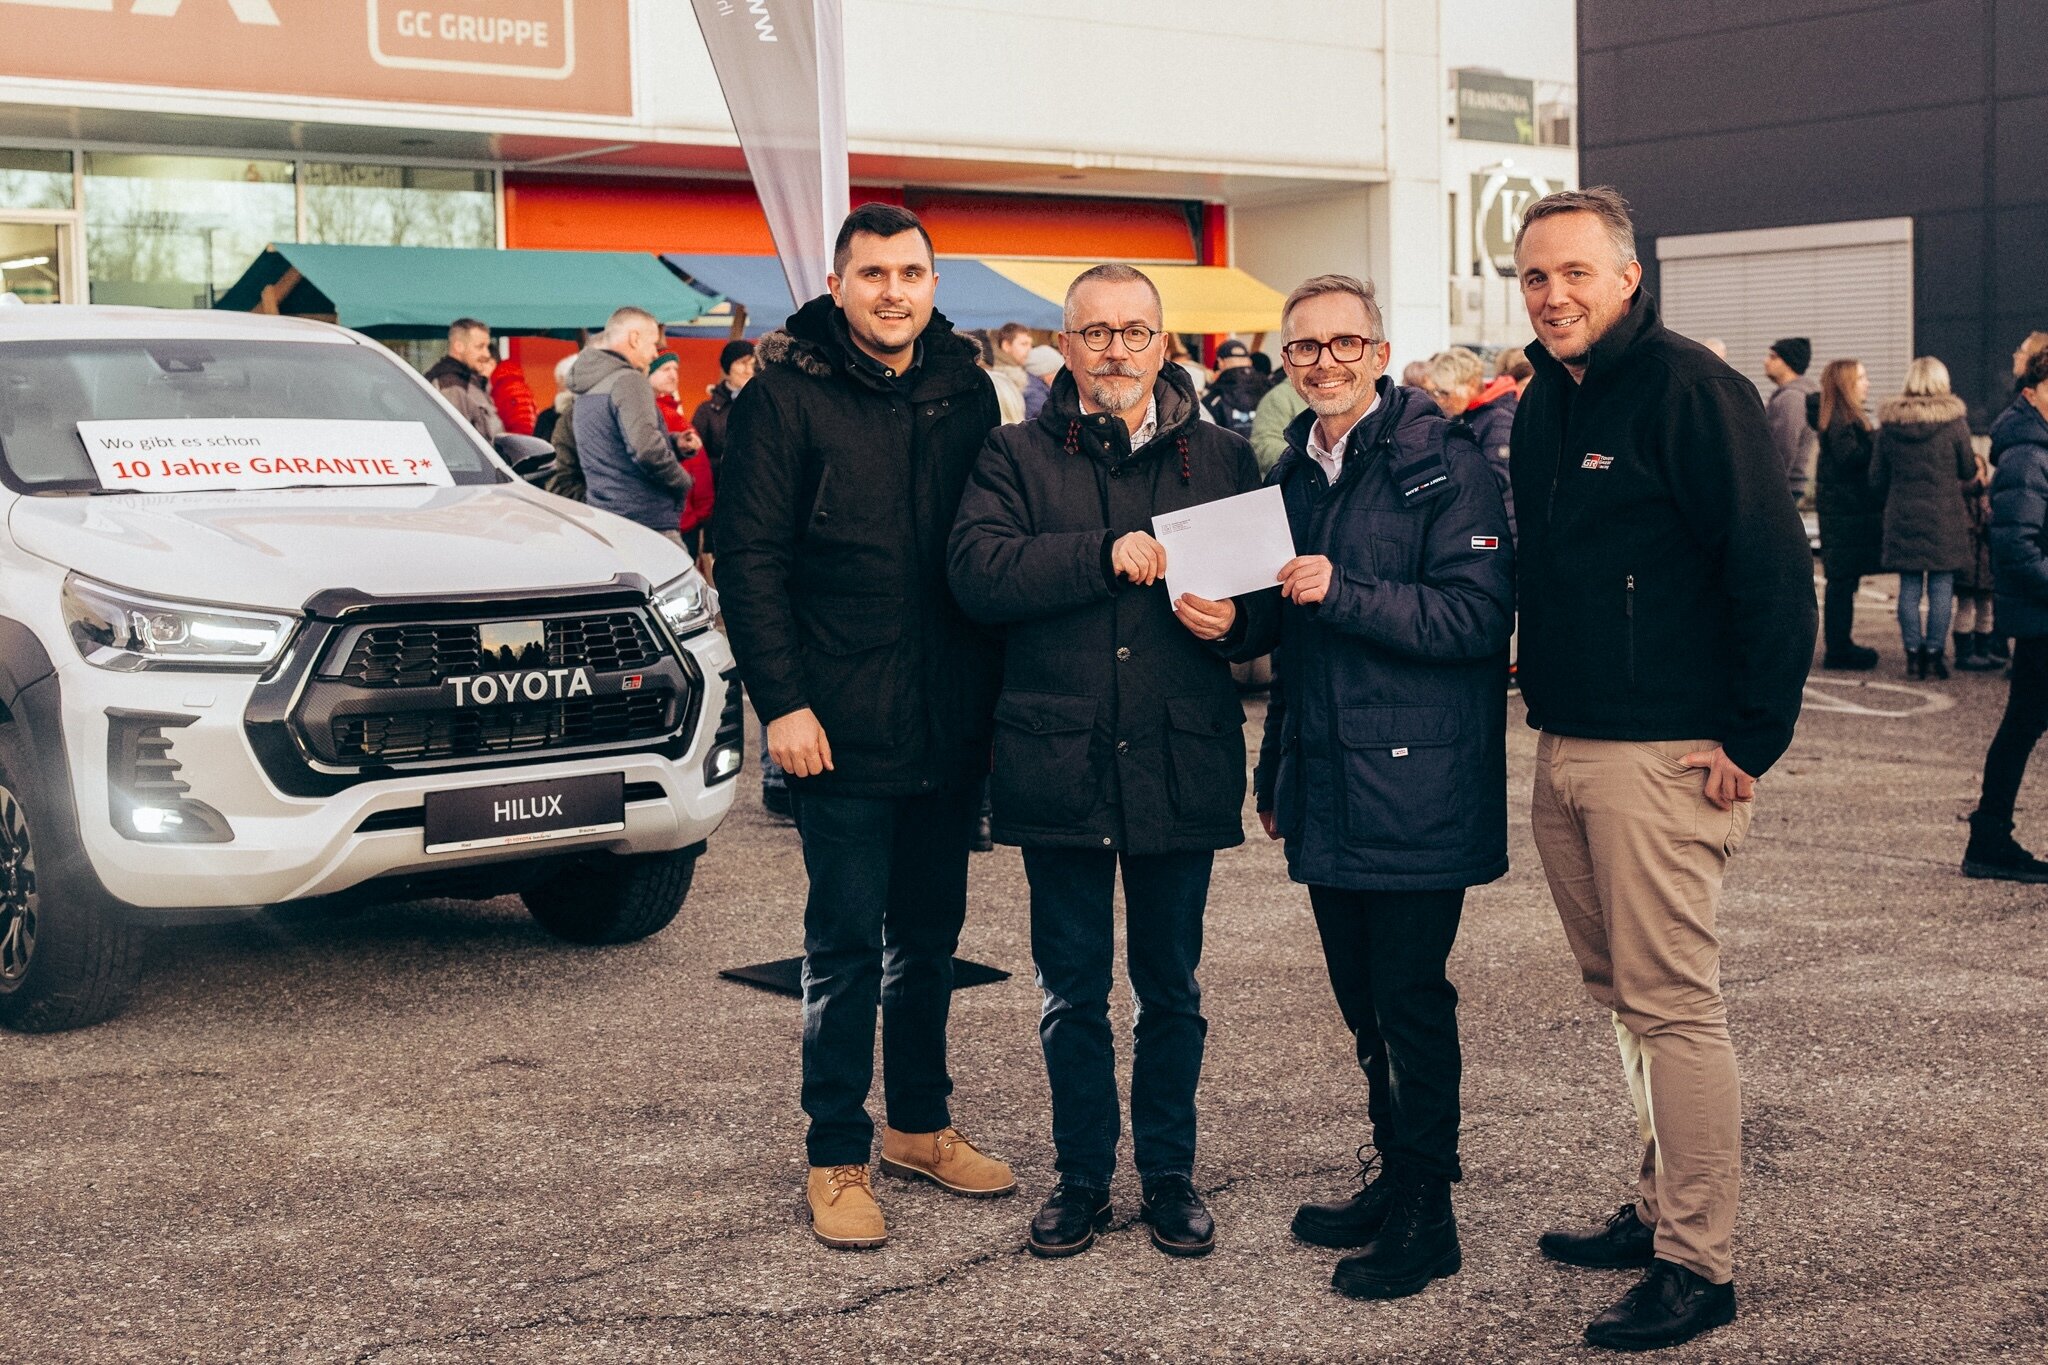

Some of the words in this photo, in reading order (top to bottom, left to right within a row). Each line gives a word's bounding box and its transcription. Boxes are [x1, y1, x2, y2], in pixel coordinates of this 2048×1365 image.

[397, 9, 432, 38] GC
[439, 13, 548, 48] GRUPPE
[100, 437, 133, 449] Wo
[140, 436, 176, 451] gibt
[181, 437, 202, 447] es
[206, 435, 261, 447] schon
[112, 460, 151, 479] 10
[161, 458, 242, 477] Jahre
[250, 457, 399, 475] GARANTIE
[1582, 458, 1599, 469] GR
[447, 668, 593, 706] TOYOTA
[622, 679, 641, 690] GR
[493, 794, 562, 822] HILUX
